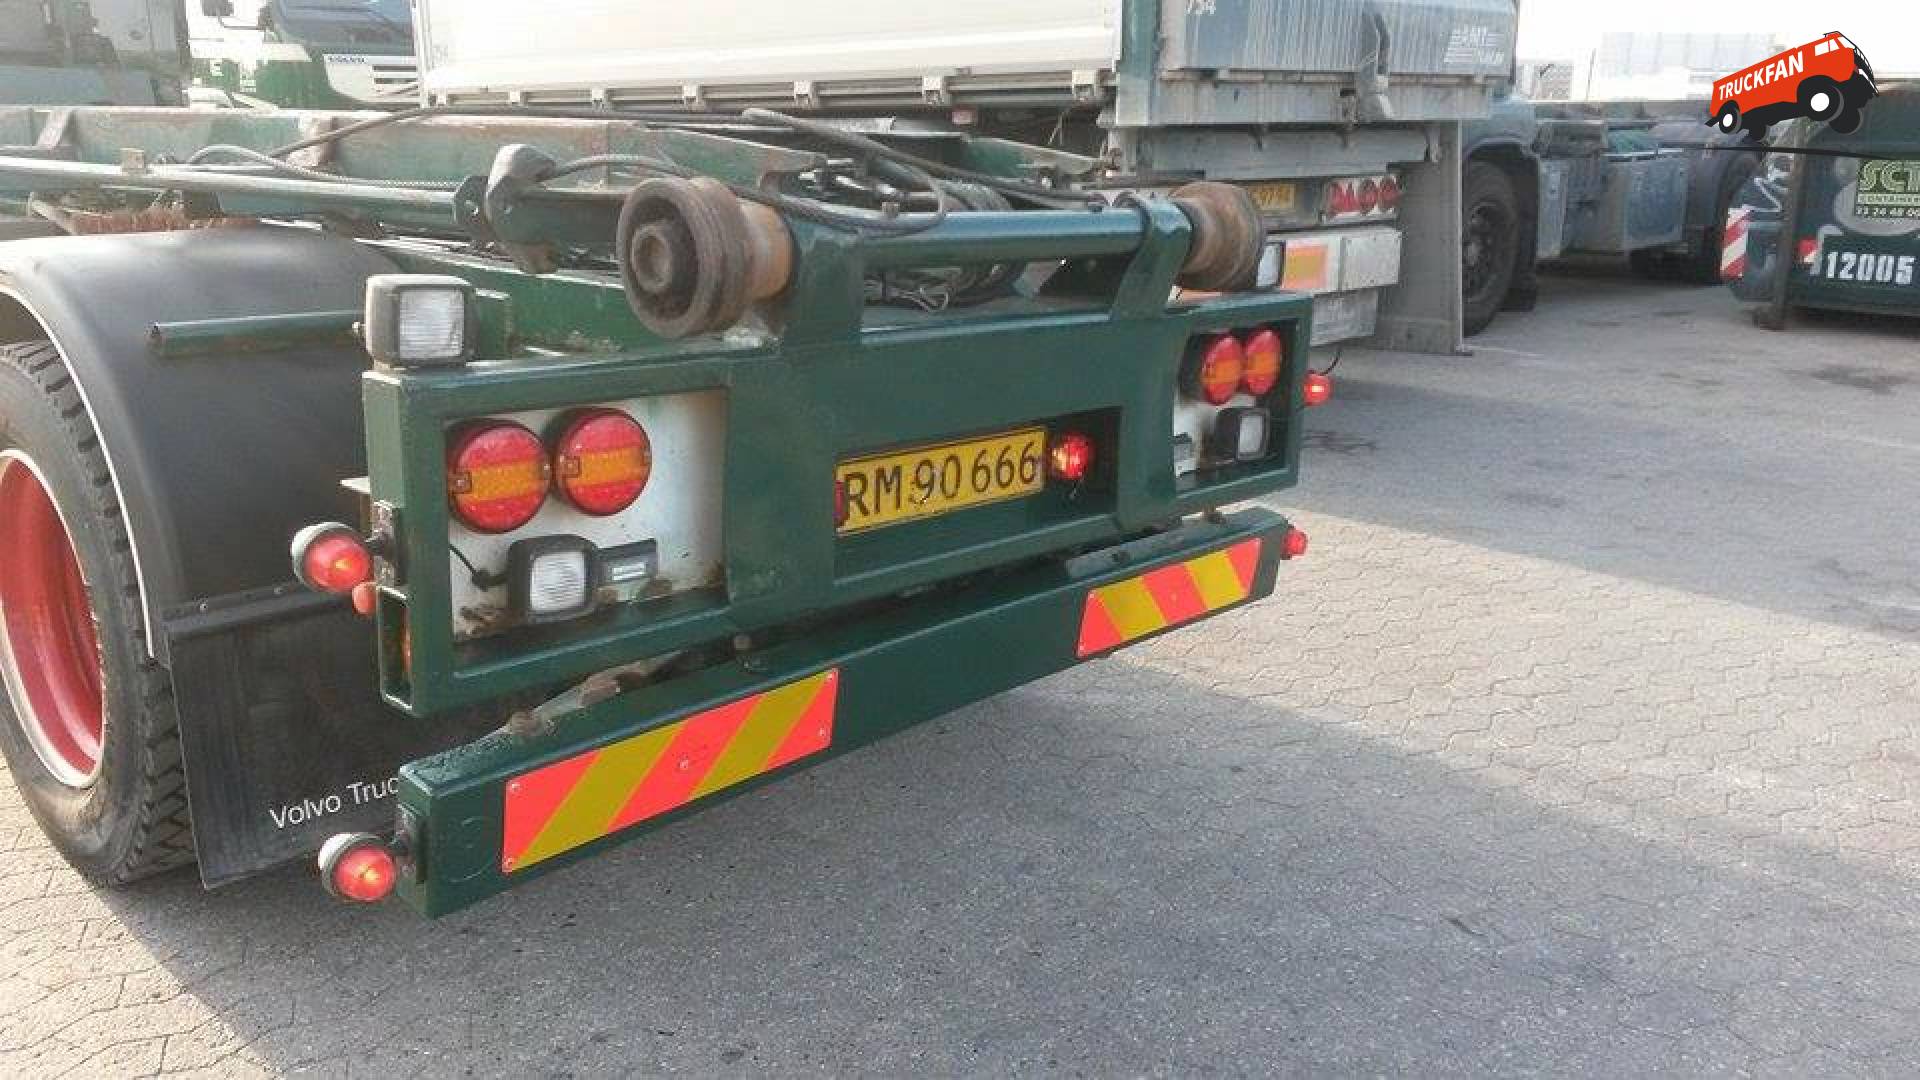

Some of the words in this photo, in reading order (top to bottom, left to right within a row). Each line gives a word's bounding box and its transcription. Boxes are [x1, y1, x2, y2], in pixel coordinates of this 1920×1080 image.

[1827, 251, 1915, 285] 12005
[843, 465, 901, 517] RM
[269, 795, 341, 829] Volvo
[346, 776, 400, 804] Truc
